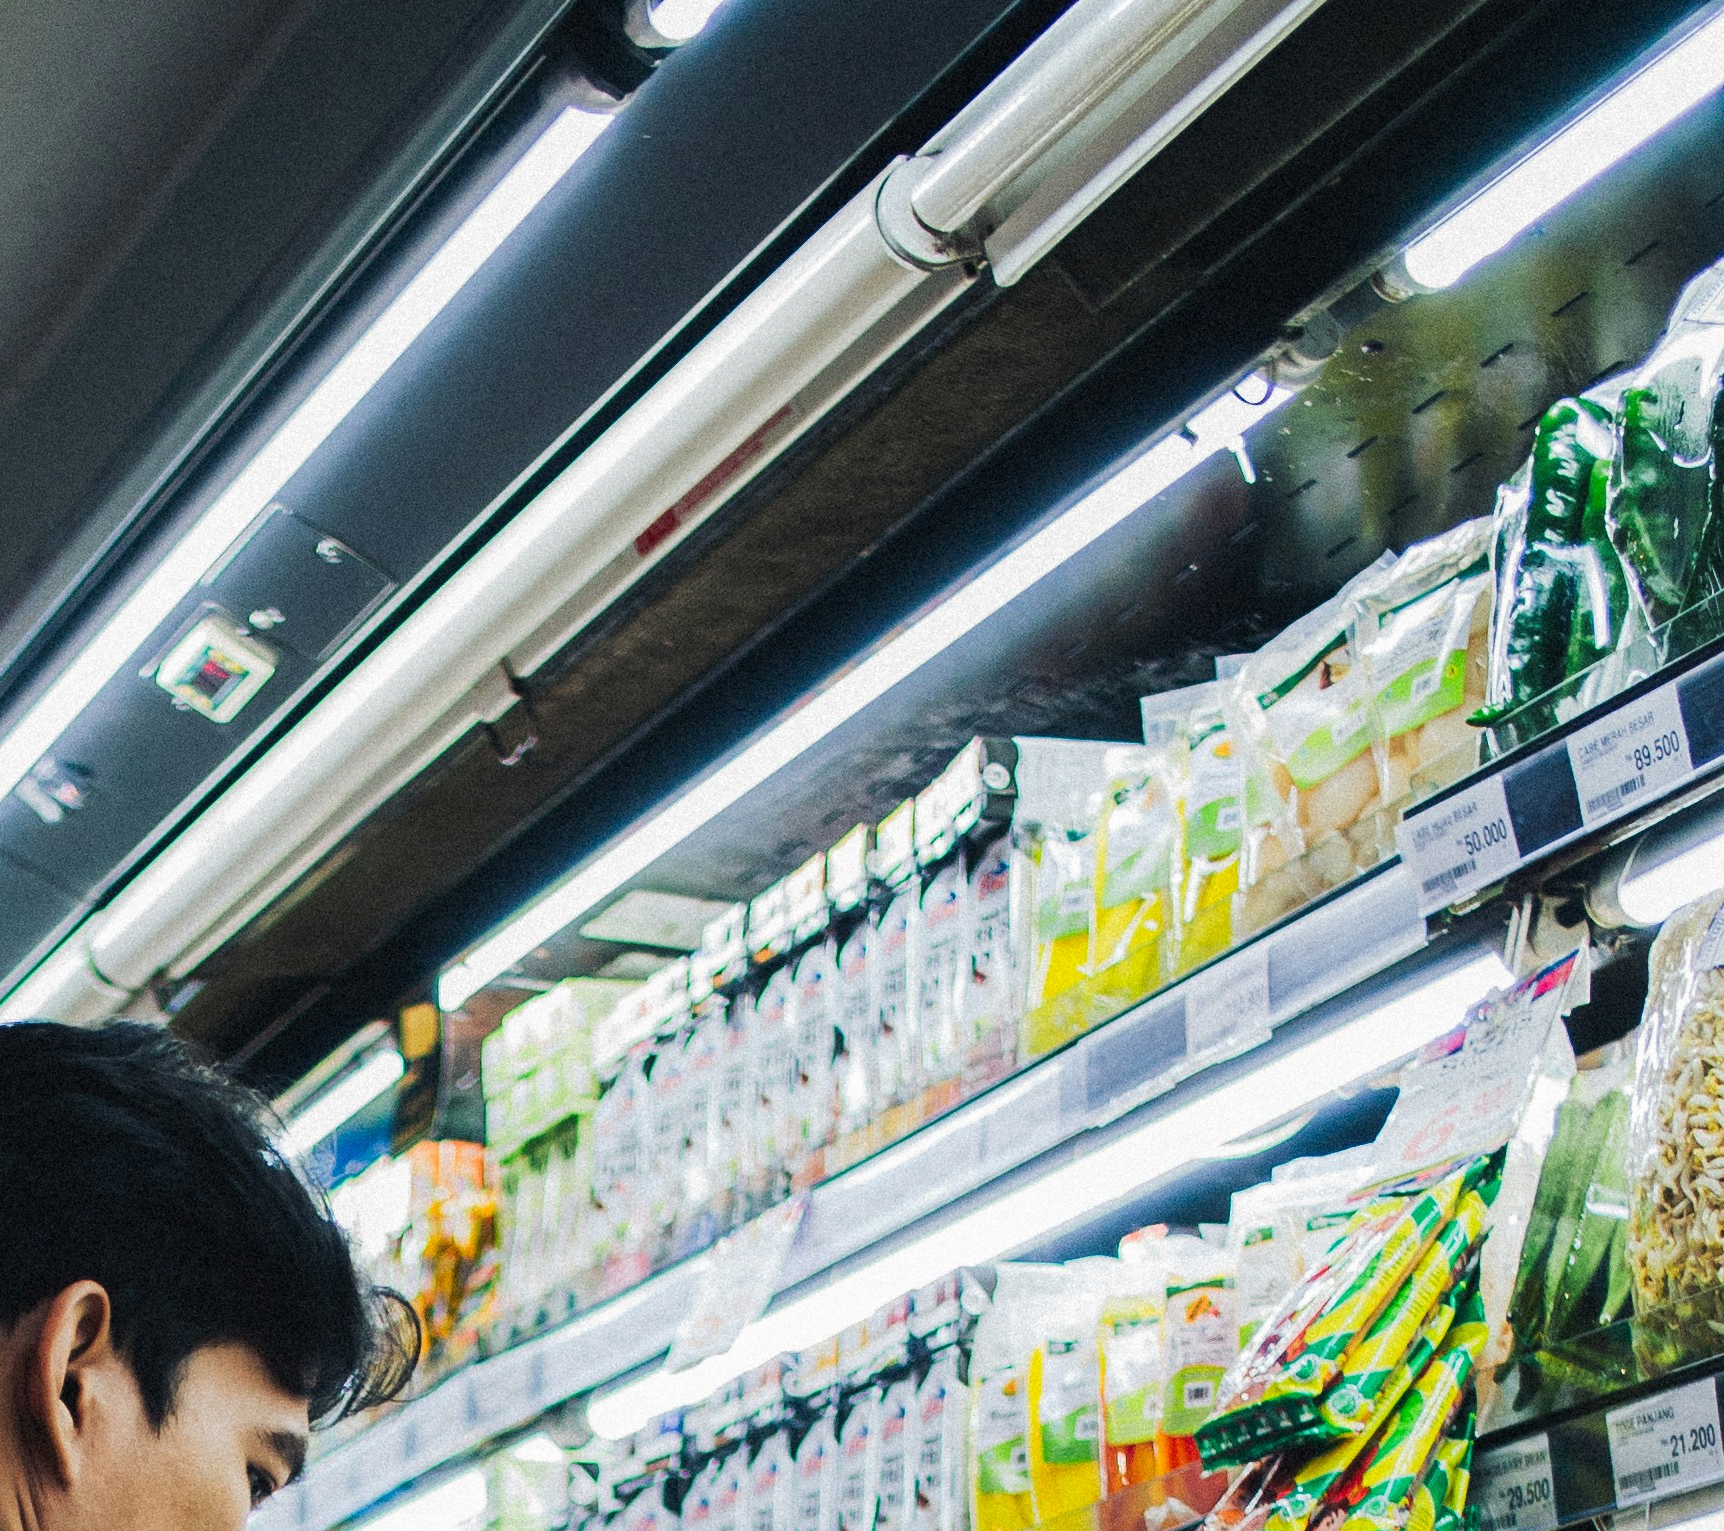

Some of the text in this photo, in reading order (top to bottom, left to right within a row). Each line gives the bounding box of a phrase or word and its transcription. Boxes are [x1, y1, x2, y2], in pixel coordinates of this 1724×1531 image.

[1634, 730, 1680, 771] 89.500
[1465, 818, 1508, 857] 50.000
[1670, 1423, 1716, 1457] 21.200
[1507, 1477, 1550, 1510] 29.500
